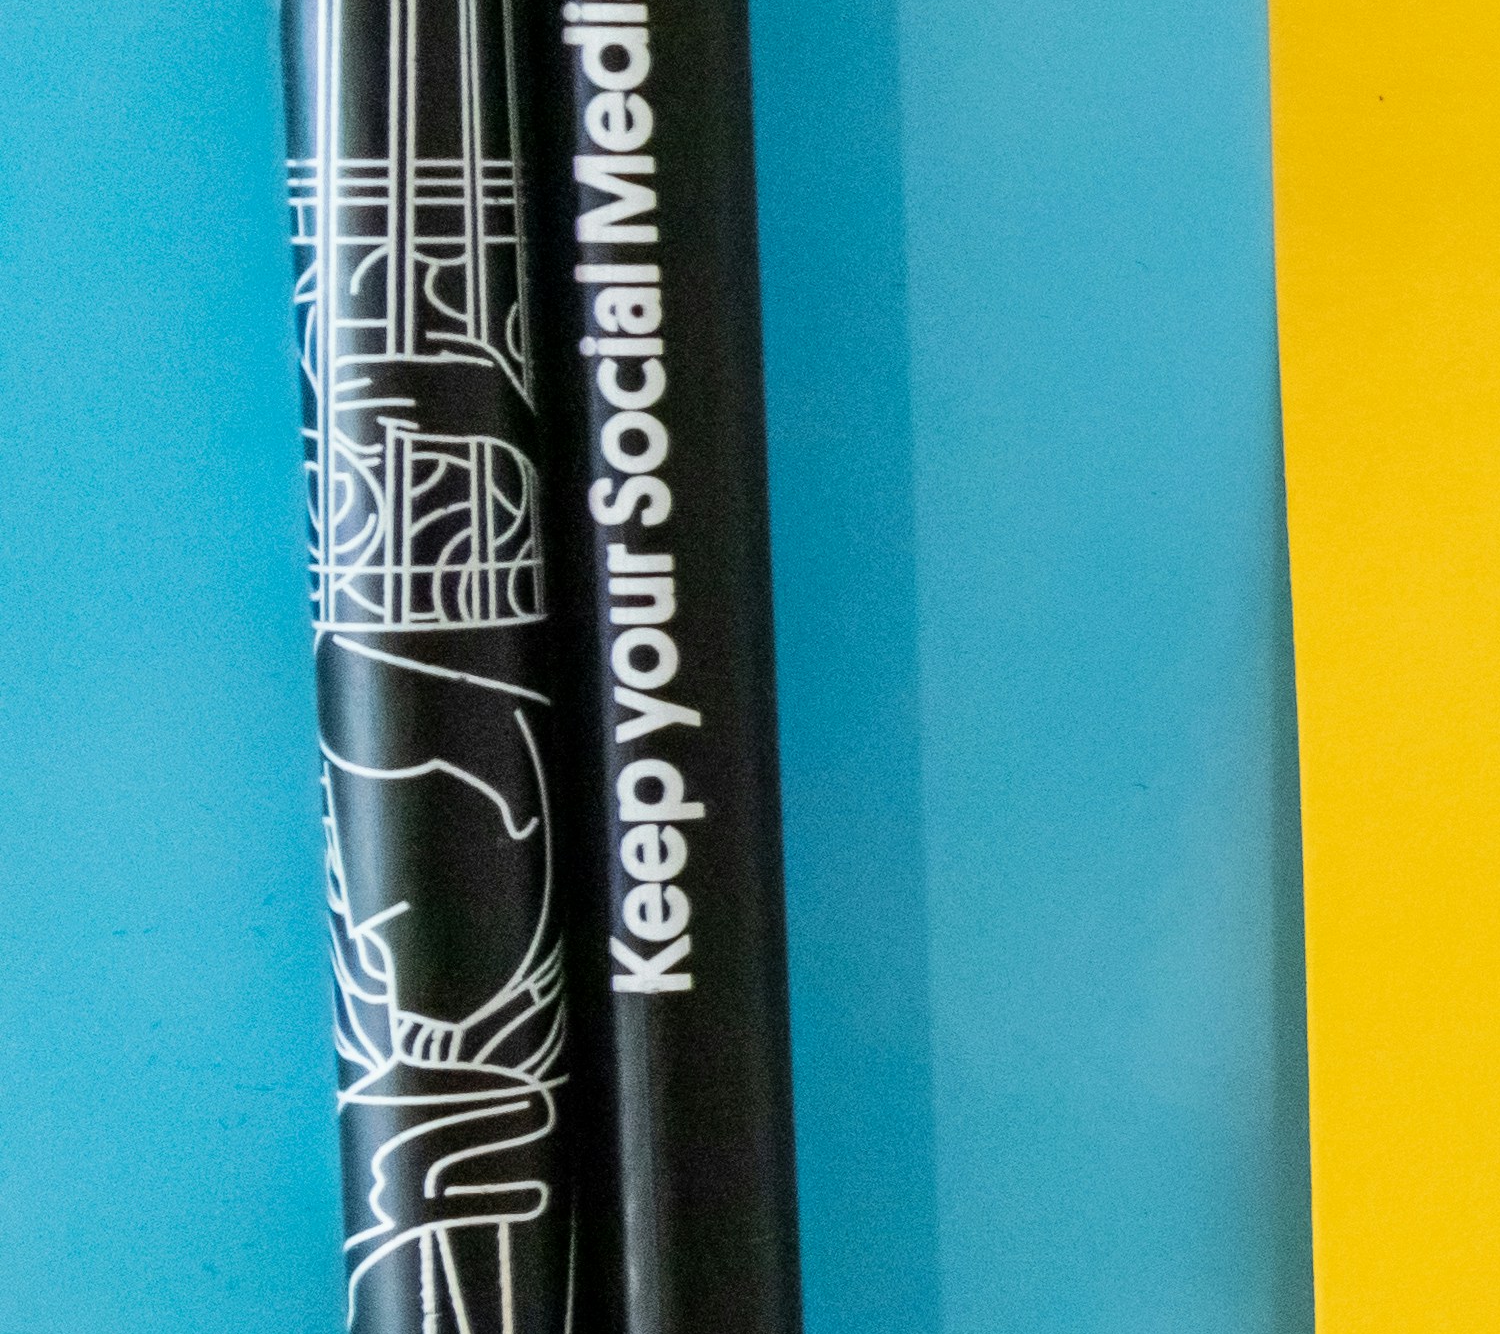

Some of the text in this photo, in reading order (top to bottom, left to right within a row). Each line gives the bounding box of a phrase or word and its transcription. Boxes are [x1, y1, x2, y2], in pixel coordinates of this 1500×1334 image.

[574, 261, 673, 527] Social
[605, 541, 703, 745] your
[608, 757, 706, 995] Keep
